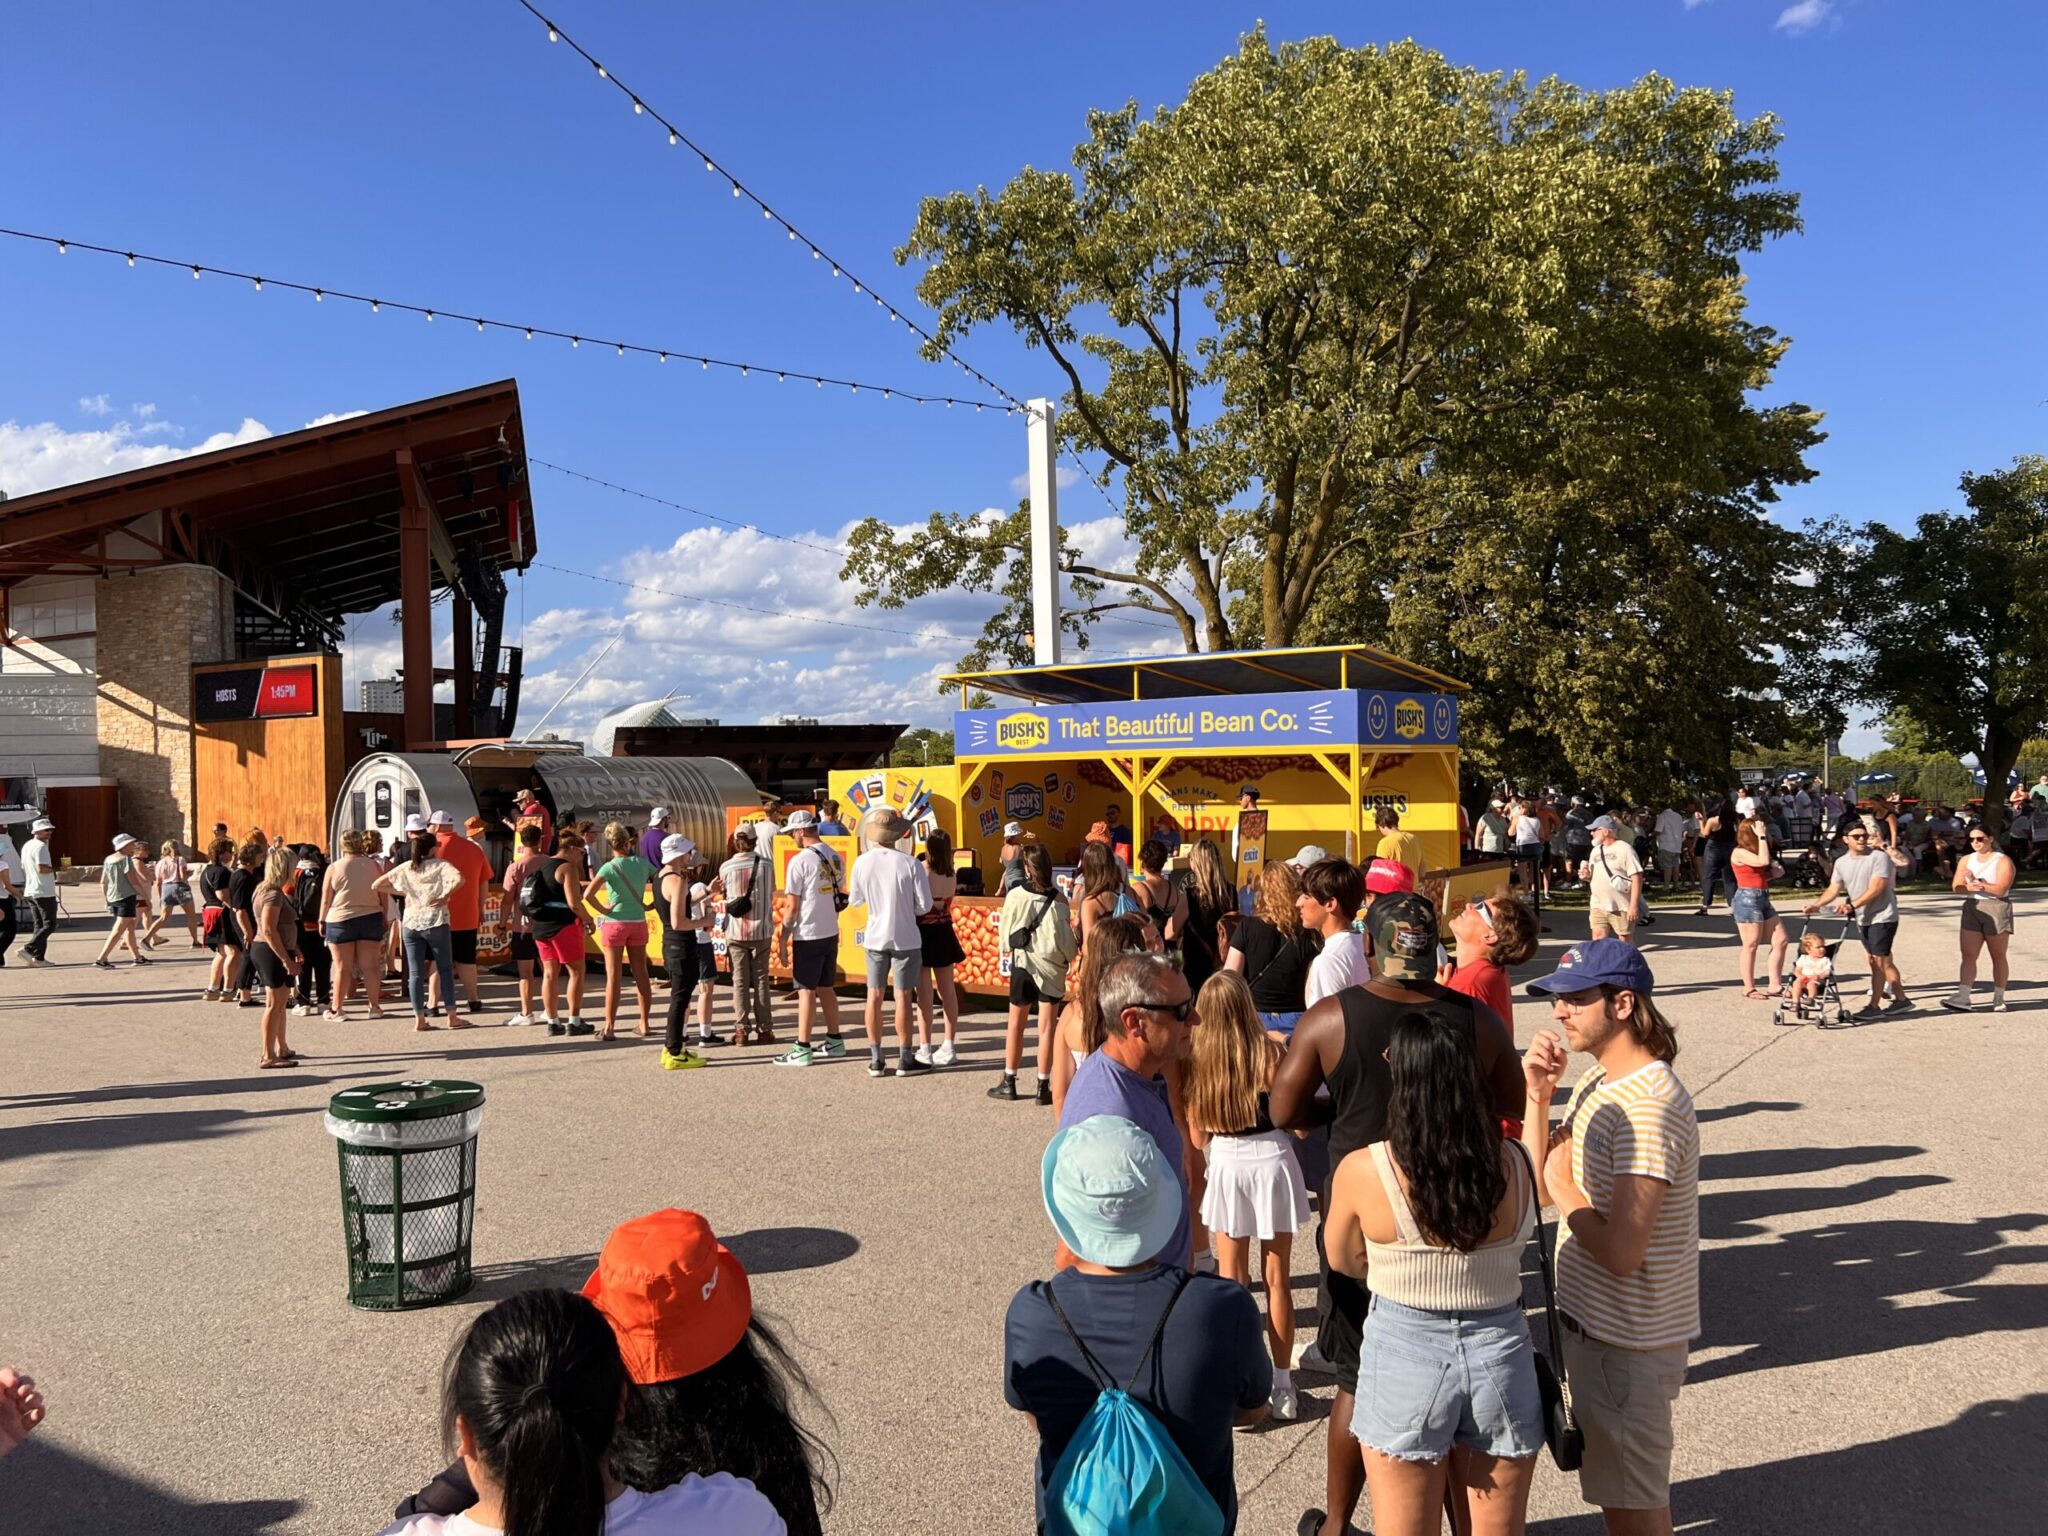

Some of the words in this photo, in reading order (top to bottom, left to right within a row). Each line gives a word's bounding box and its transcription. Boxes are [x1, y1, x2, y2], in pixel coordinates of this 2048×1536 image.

[215, 688, 238, 702] HOSTS
[270, 684, 297, 698] 1:45PM
[1058, 717, 1101, 738] That
[1106, 711, 1194, 737] Beautiful
[1200, 711, 1255, 733] Bean
[1396, 709, 1424, 729] BUSH'S
[1000, 721, 1046, 742] BUSH'S
[546, 776, 669, 811] BUSH'S
[1008, 793, 1041, 812] BUSH'S
[1192, 786, 1219, 801] MAKE
[1361, 794, 1408, 813] USH'S
[598, 811, 632, 824] BEST
[1243, 848, 1258, 861] exit
